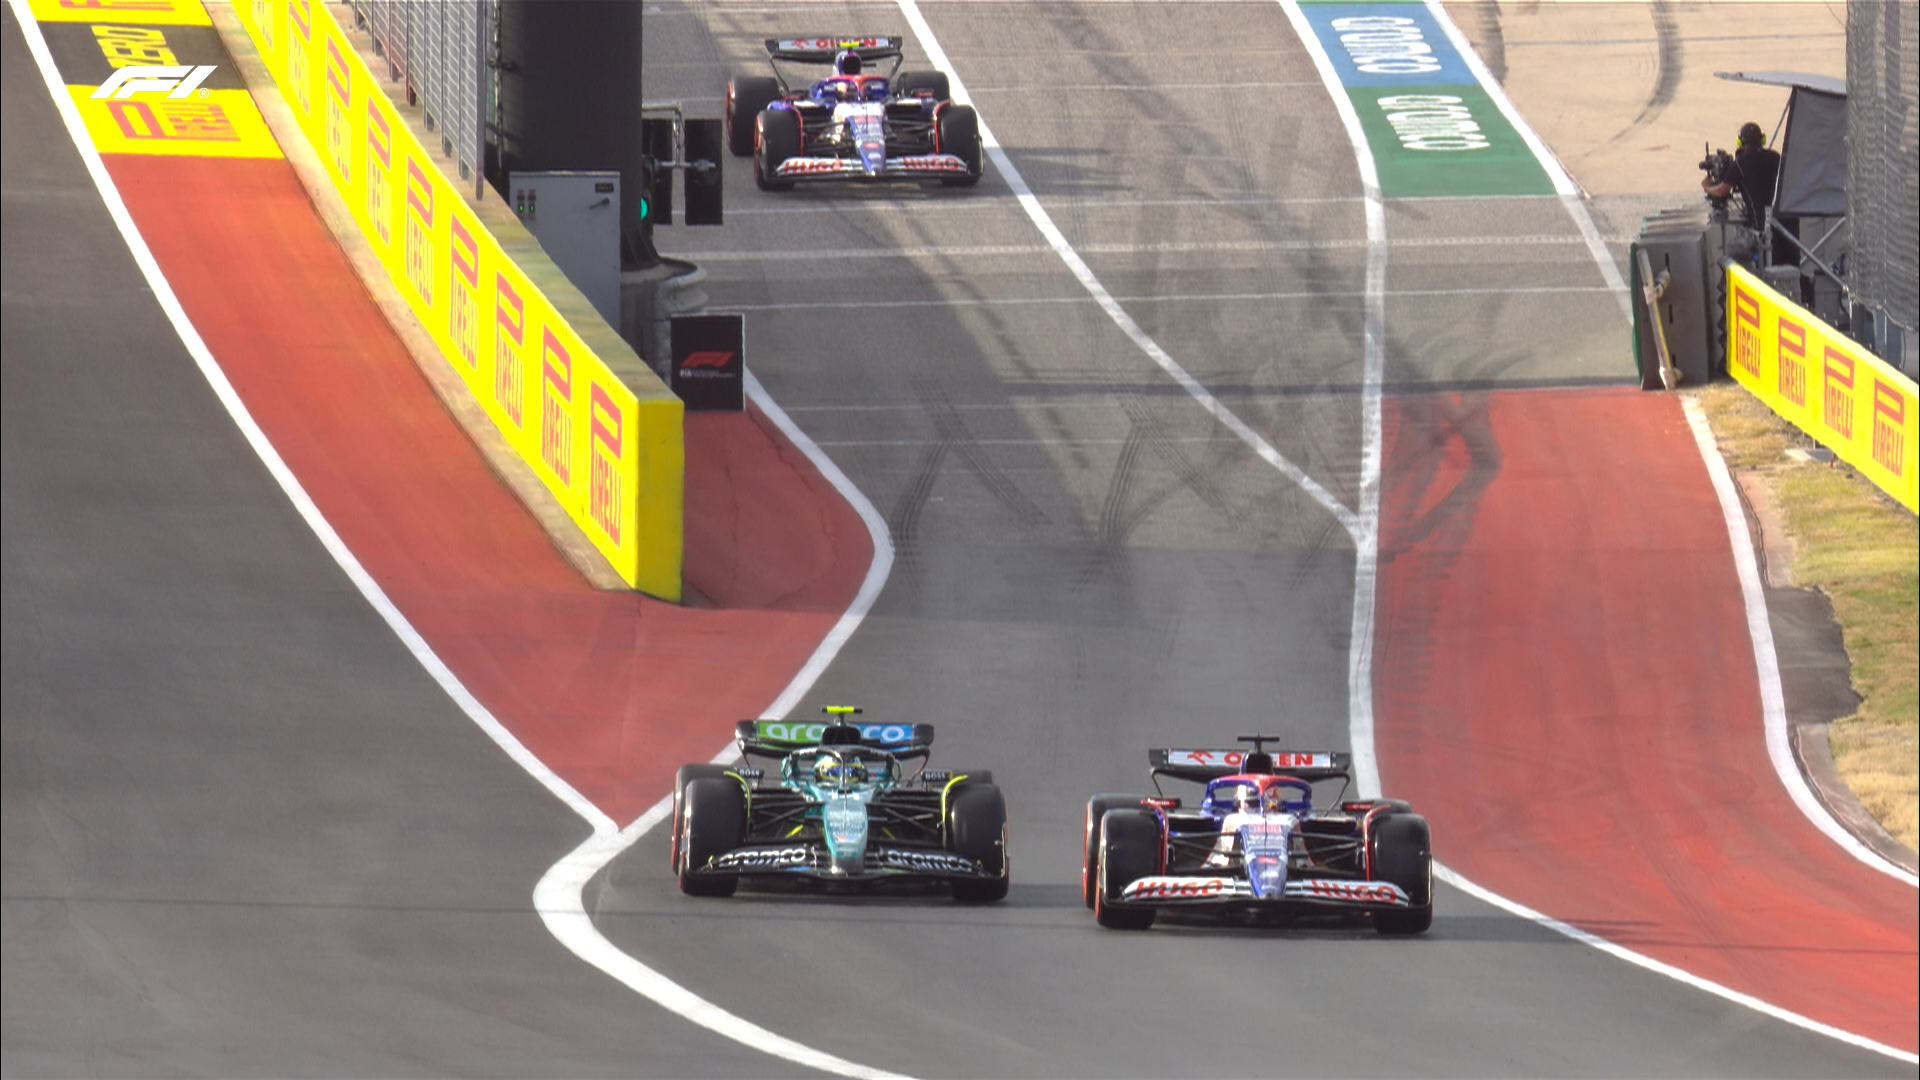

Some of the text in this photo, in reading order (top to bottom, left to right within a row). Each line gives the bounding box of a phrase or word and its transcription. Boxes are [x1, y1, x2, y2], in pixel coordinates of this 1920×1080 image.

[783, 159, 844, 174] HUGO
[902, 156, 959, 171] HUGO
[406, 153, 434, 308] PIRELLI
[449, 212, 478, 371] PIRELLI
[1735, 284, 1761, 379] PIRELLI
[495, 270, 524, 431] PIRELLI
[1778, 315, 1806, 408] PIRELLI
[1824, 345, 1854, 441] PIRELLI
[542, 324, 571, 488] PIRELLI
[1872, 377, 1905, 478] PIRELLI
[590, 379, 622, 548] PIRELLI
[766, 724, 905, 741] araco
[718, 848, 806, 868] aramco
[887, 849, 973, 872] aramco
[1134, 879, 1223, 898] HUGO
[1310, 879, 1397, 902] HUGO
